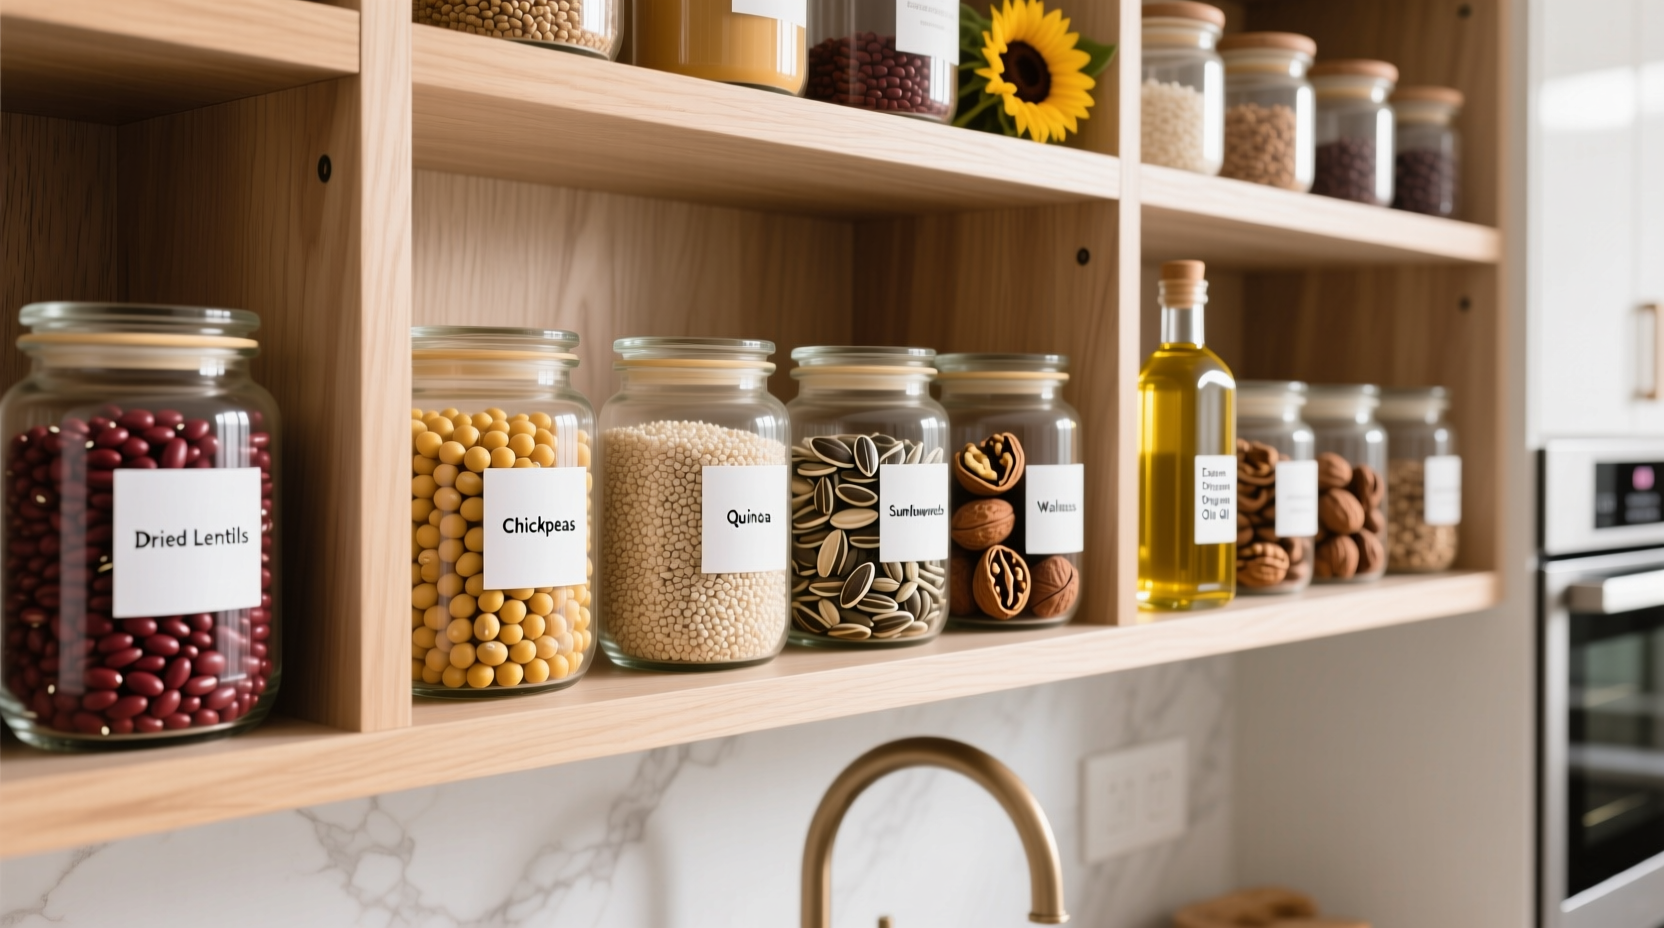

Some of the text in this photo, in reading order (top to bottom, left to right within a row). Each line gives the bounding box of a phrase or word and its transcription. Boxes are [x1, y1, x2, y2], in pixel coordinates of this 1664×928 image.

[502, 516, 575, 537] Chickpeas
[727, 507, 771, 529] Quinoa
[135, 526, 249, 549] Dried Lentils
